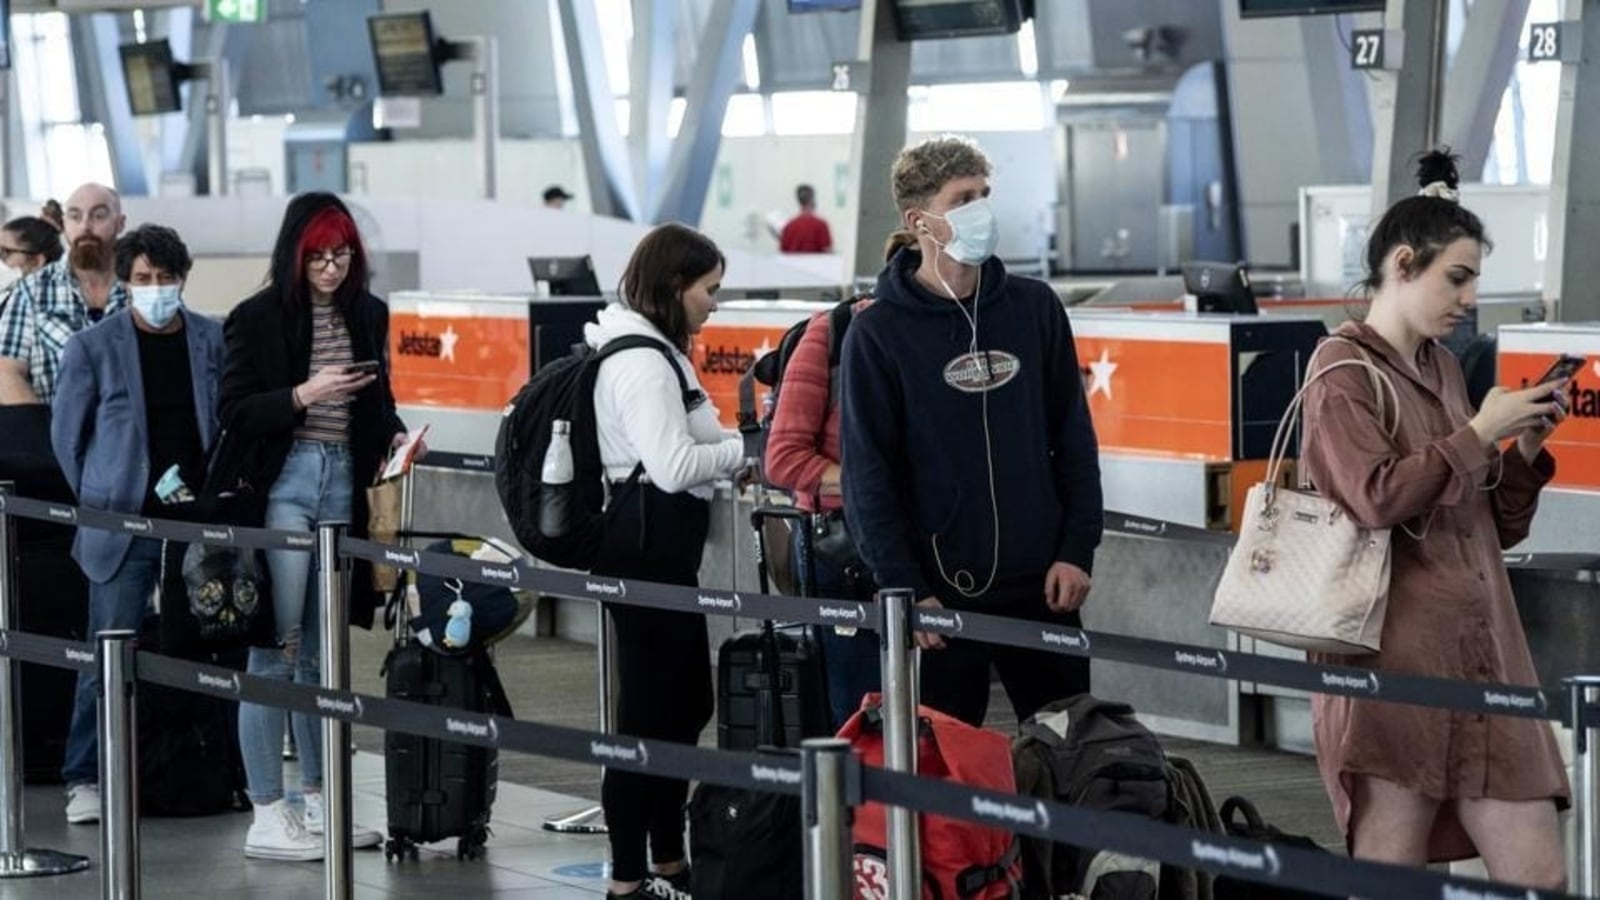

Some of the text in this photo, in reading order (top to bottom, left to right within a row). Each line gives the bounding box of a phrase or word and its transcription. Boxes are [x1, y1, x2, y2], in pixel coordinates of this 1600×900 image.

[1356, 35, 1379, 65] 27
[1533, 27, 1556, 57] 28
[819, 605, 857, 619] Sydney Airport
[1175, 651, 1216, 667] Sydney Airport
[1322, 672, 1368, 688] Sydney Airport
[1484, 691, 1535, 708] Sydney Airport
